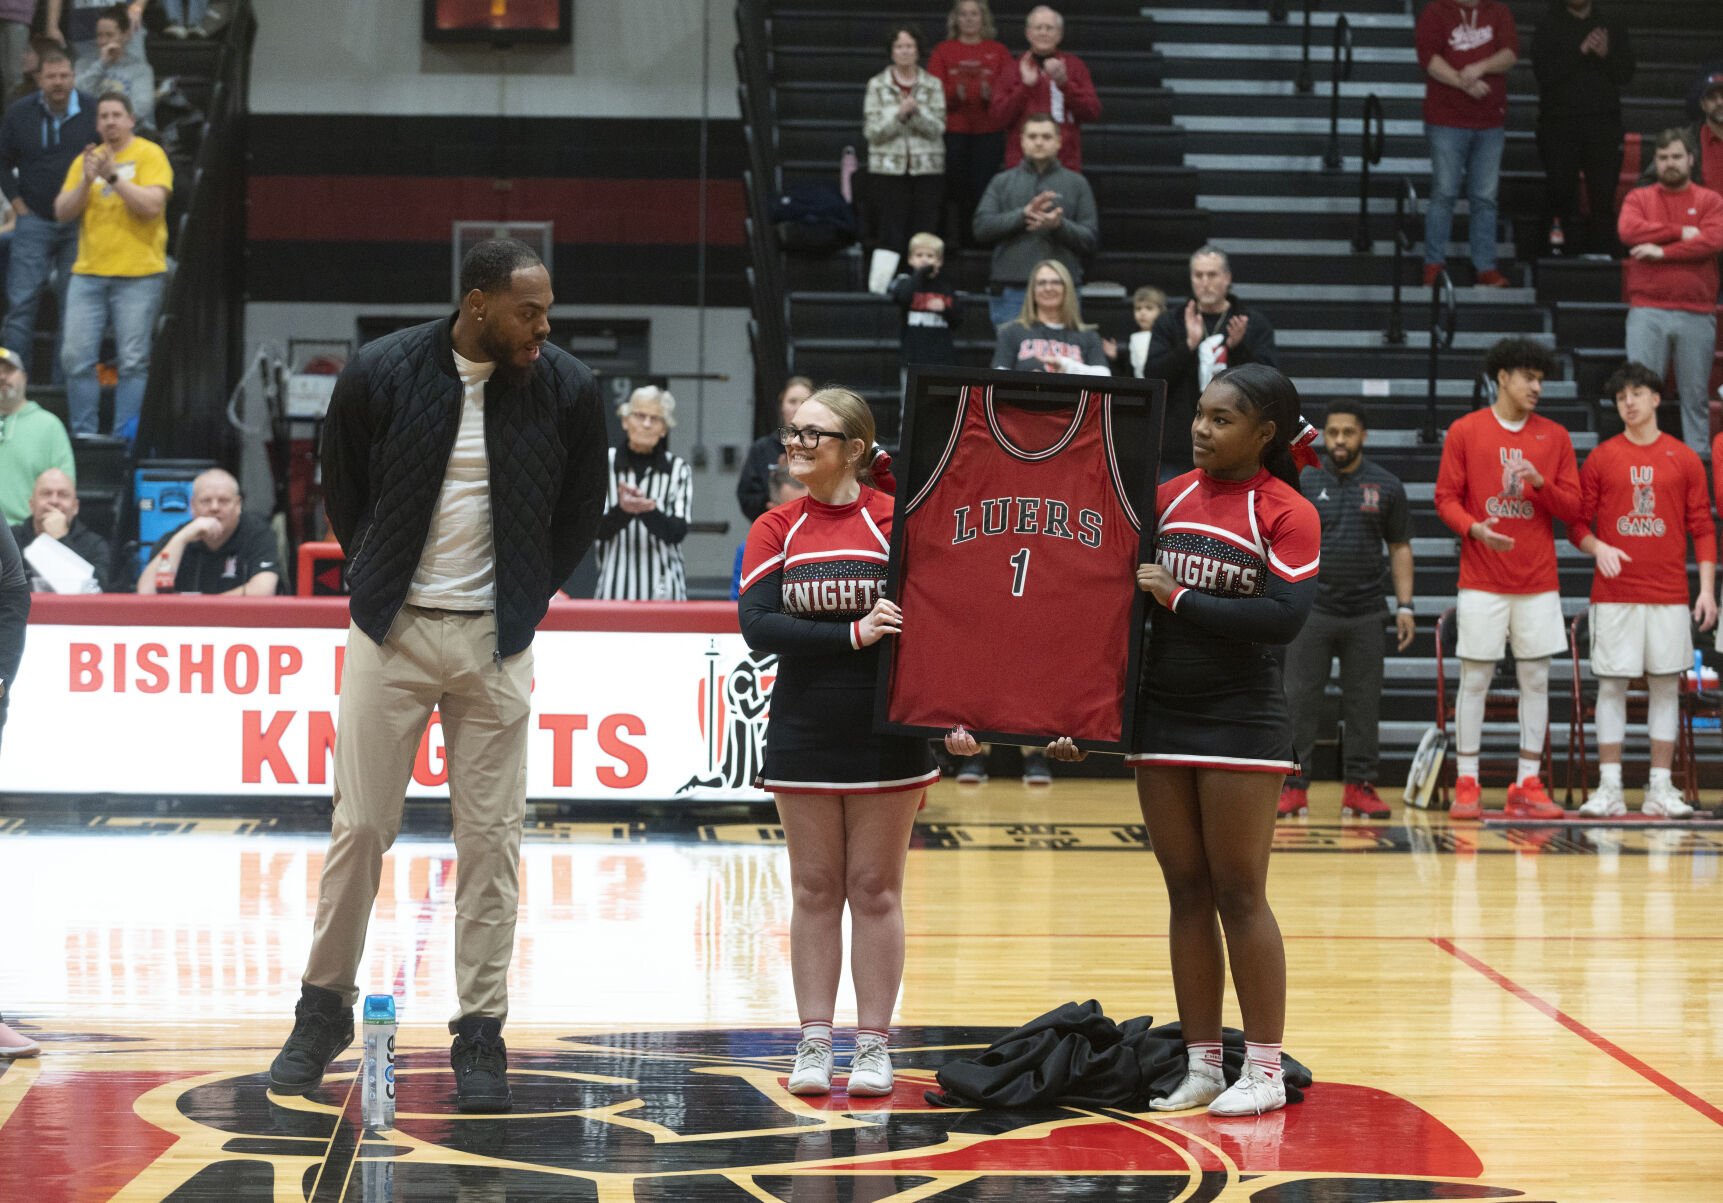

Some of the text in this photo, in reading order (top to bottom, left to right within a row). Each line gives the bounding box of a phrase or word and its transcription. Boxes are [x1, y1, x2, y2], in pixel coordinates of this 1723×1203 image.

[1630, 466, 1654, 485] LU
[952, 497, 1103, 548] LUERS
[1486, 496, 1535, 520] GANG
[1617, 516, 1667, 537] GANG
[1010, 548, 1031, 597] 1
[1156, 548, 1257, 595] NIGHTS
[68, 642, 302, 694] BISHOP
[241, 710, 649, 789] KNGTS
